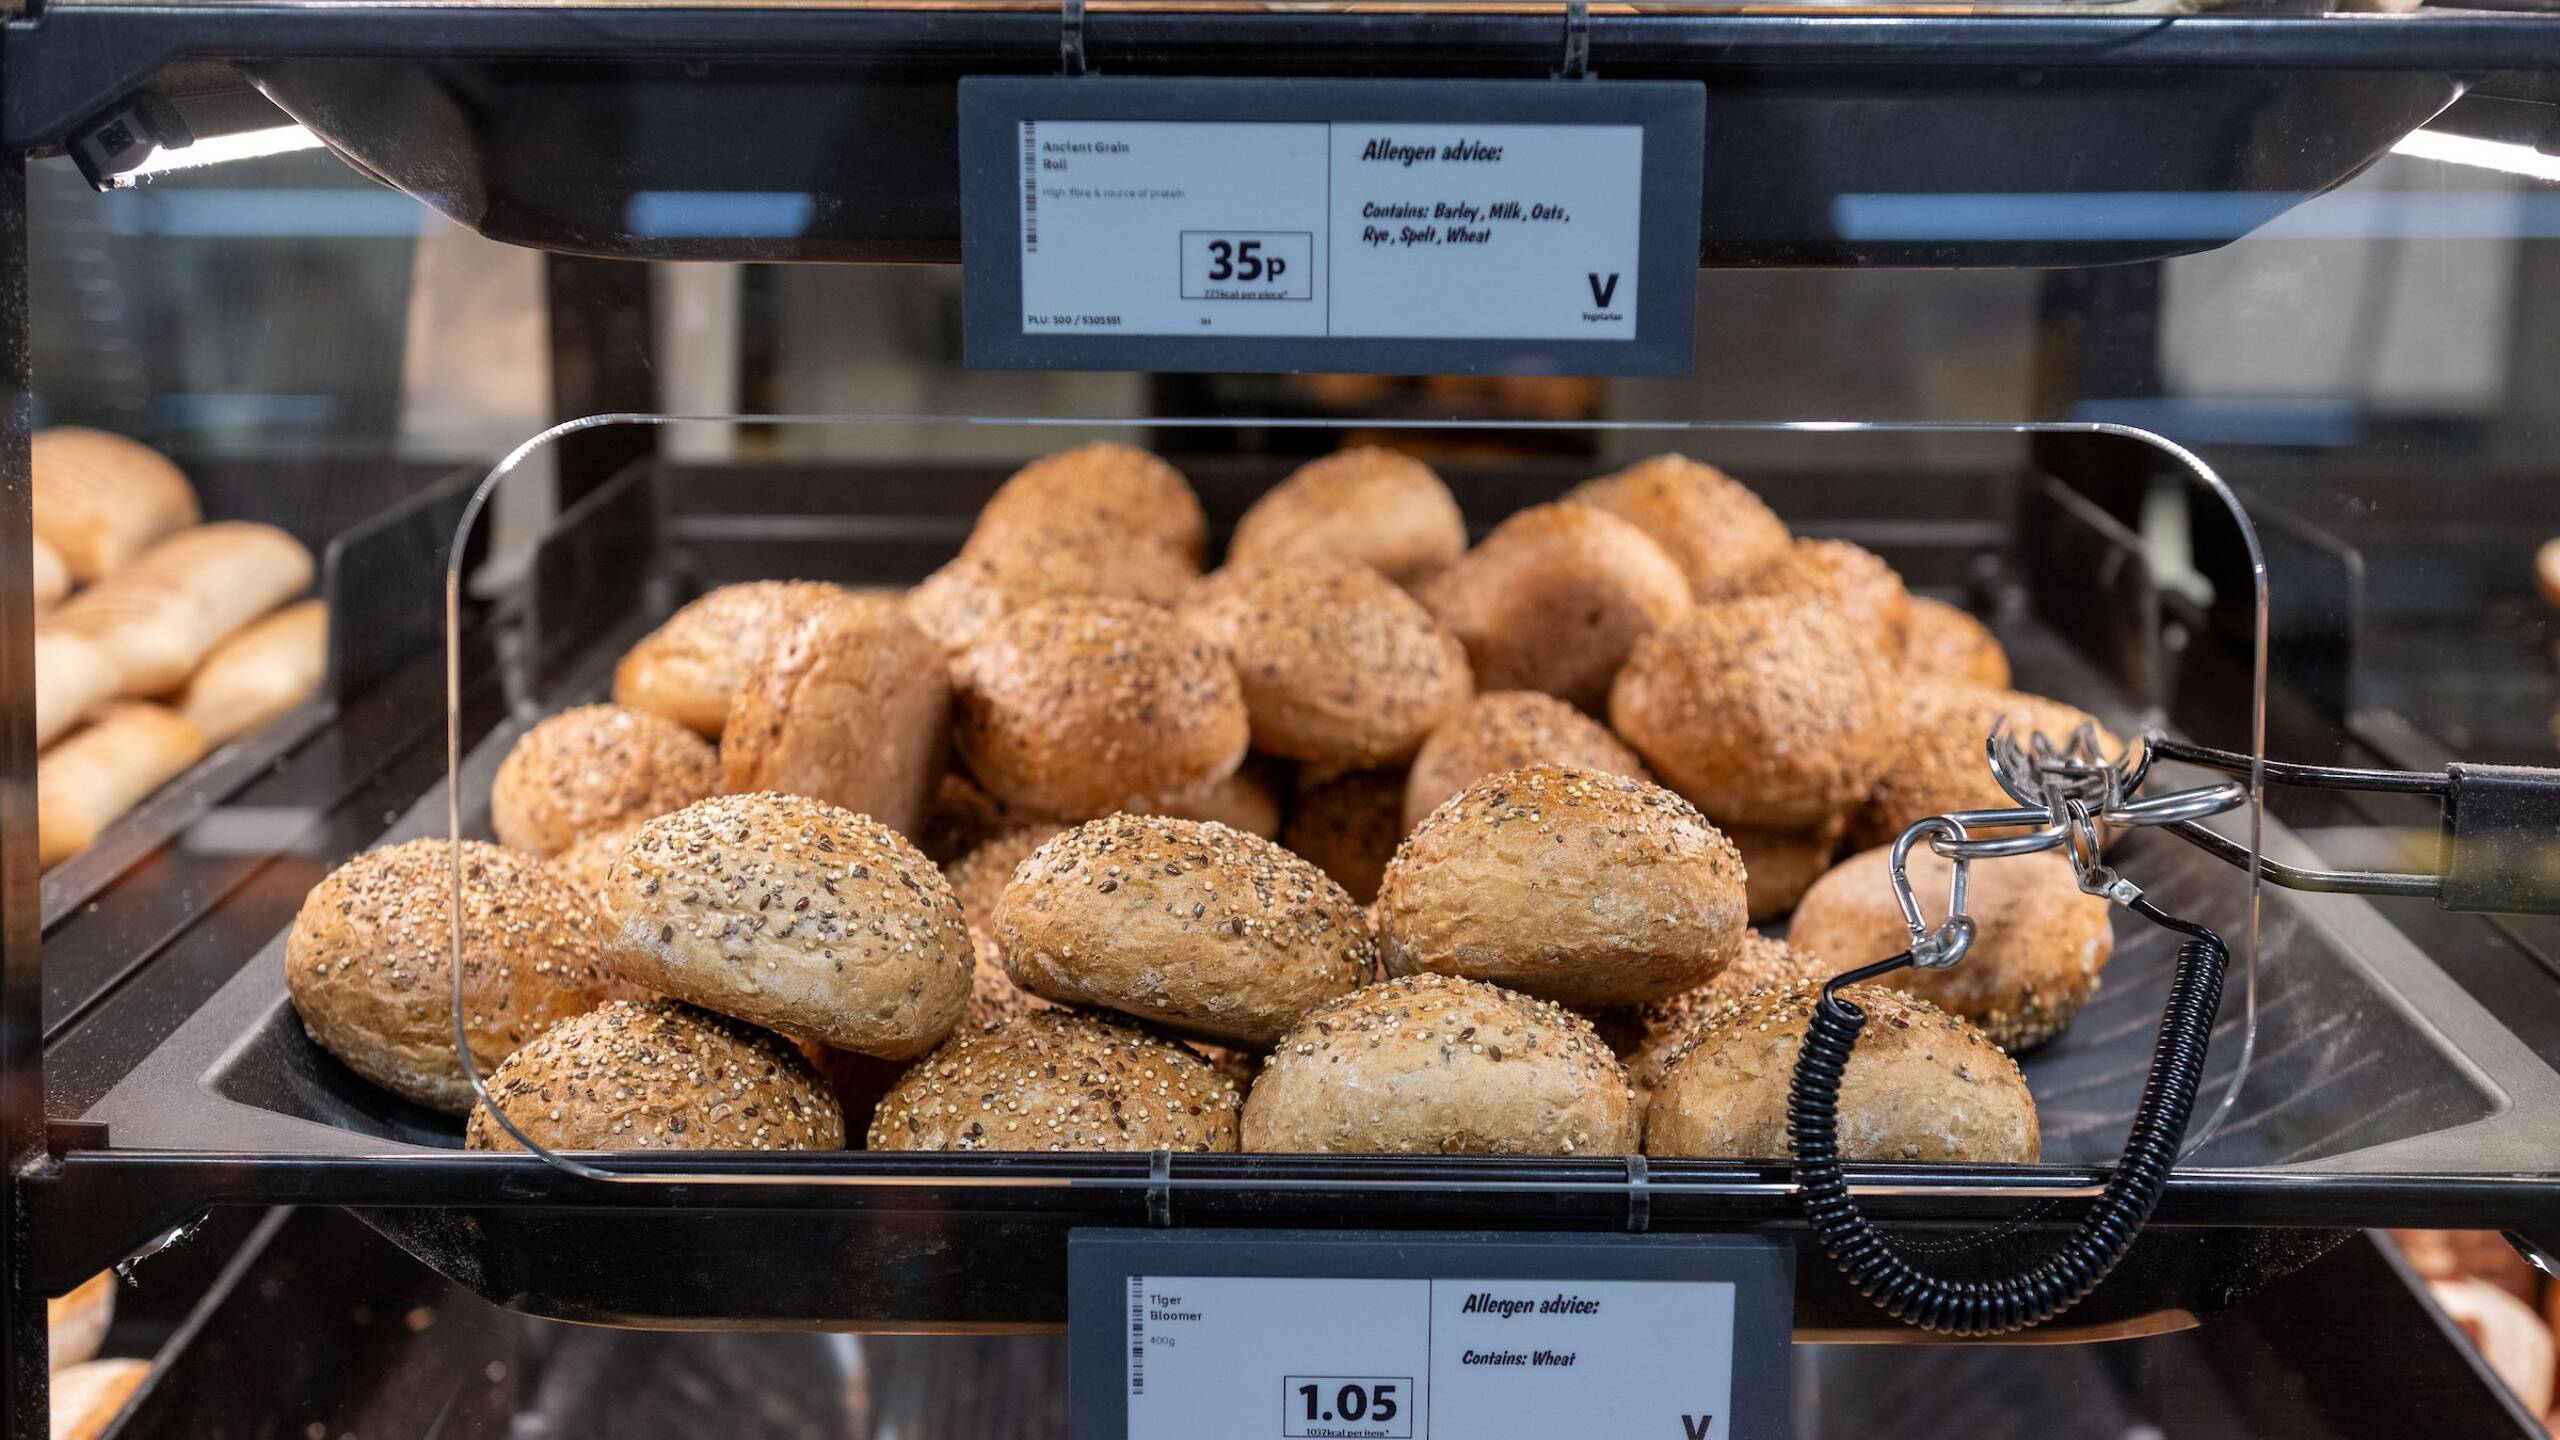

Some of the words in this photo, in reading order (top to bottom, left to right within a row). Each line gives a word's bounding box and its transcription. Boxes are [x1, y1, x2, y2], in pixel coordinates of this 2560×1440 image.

[1042, 141, 1092, 153] Ancient
[1095, 141, 1130, 153] Grain
[1361, 138, 1436, 167] Allergen
[1441, 138, 1503, 161] advice:
[1042, 158, 1068, 170] Roll
[1362, 202, 1429, 219] Contains:
[1446, 227, 1491, 243] Wheat
[1207, 239, 1287, 282] 35p
[1588, 272, 1620, 308] V
[1582, 311, 1623, 322] Vegetarian
[1150, 1294, 1182, 1307] Tiger
[1462, 1293, 1535, 1319] Allergen
[1539, 1293, 1601, 1315] advice:
[1150, 1310, 1203, 1322] Bloomer
[1150, 1335, 1176, 1347] 400g
[1462, 1350, 1527, 1366] Contains:
[1531, 1350, 1576, 1367] Wheat
[1299, 1384, 1398, 1422] 1.05
[1681, 1415, 1713, 1440] V
